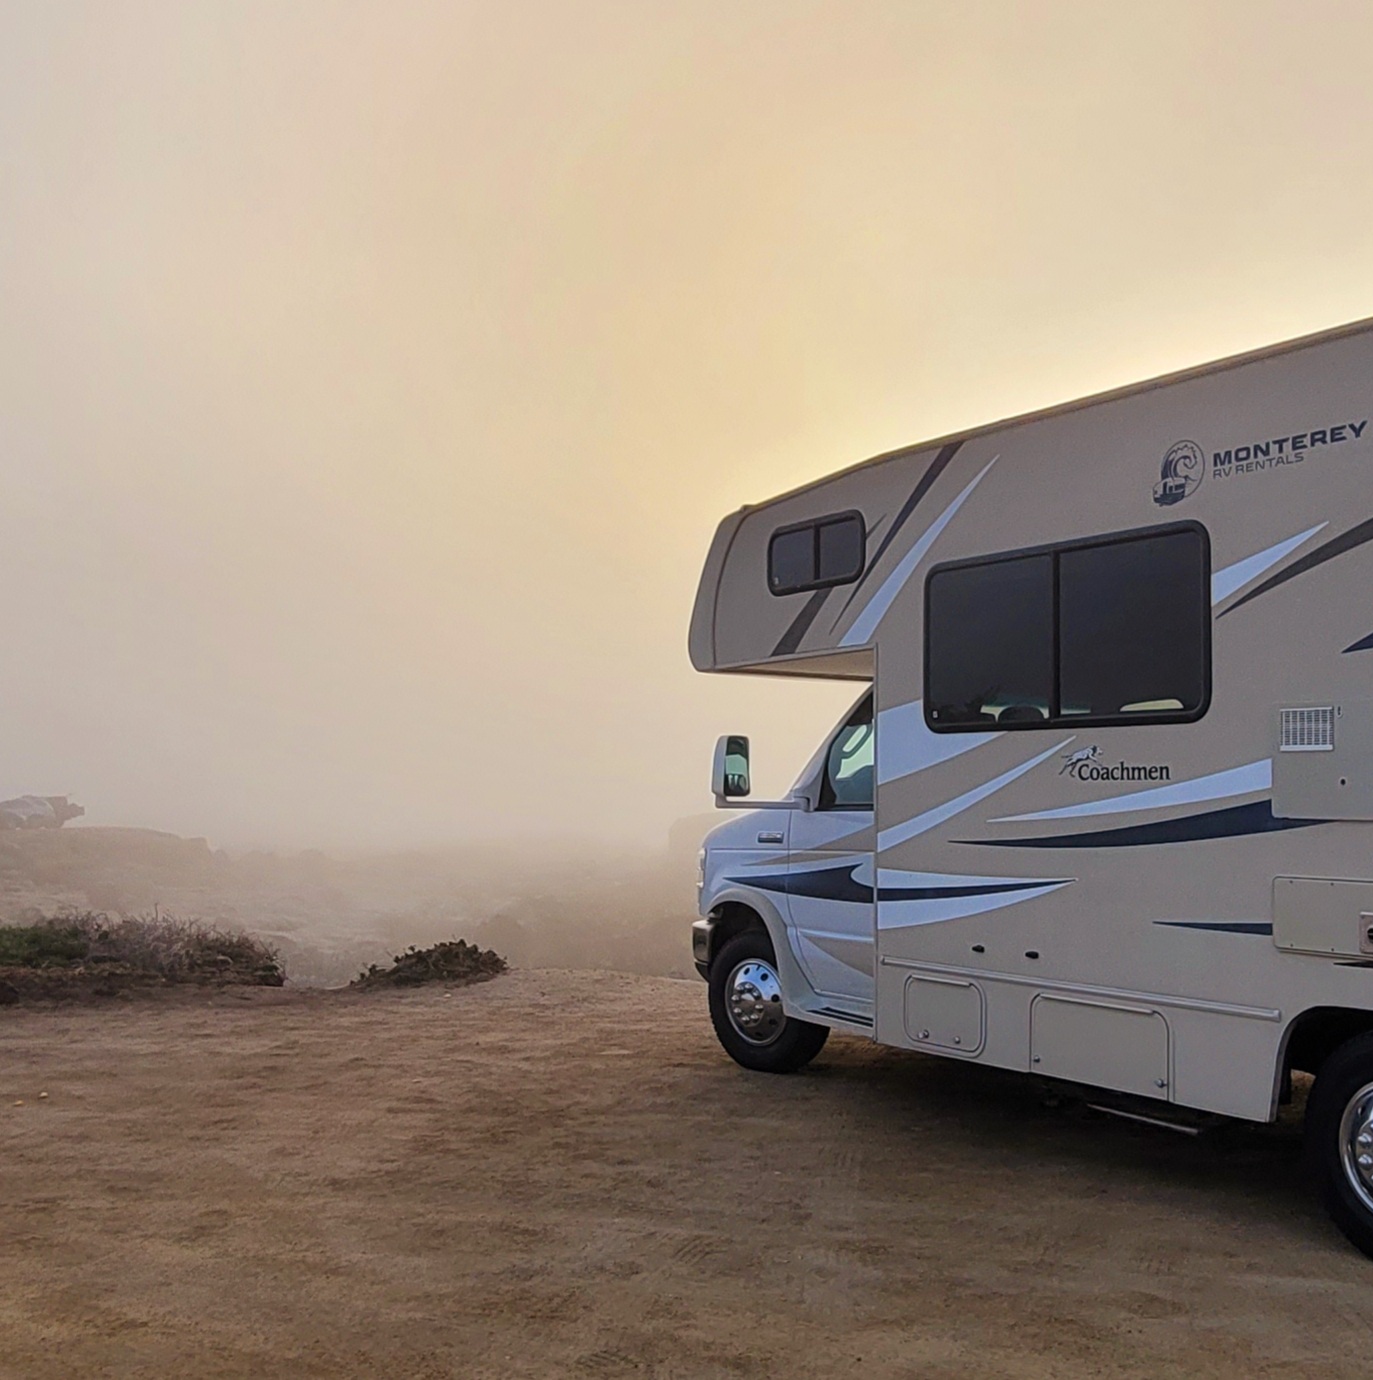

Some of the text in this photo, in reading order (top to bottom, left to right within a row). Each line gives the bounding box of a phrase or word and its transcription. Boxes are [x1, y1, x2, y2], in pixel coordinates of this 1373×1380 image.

[1212, 420, 1368, 468] MONTEREY
[1212, 451, 1305, 480] RV RENTALS
[1078, 761, 1171, 781] Coachmen
